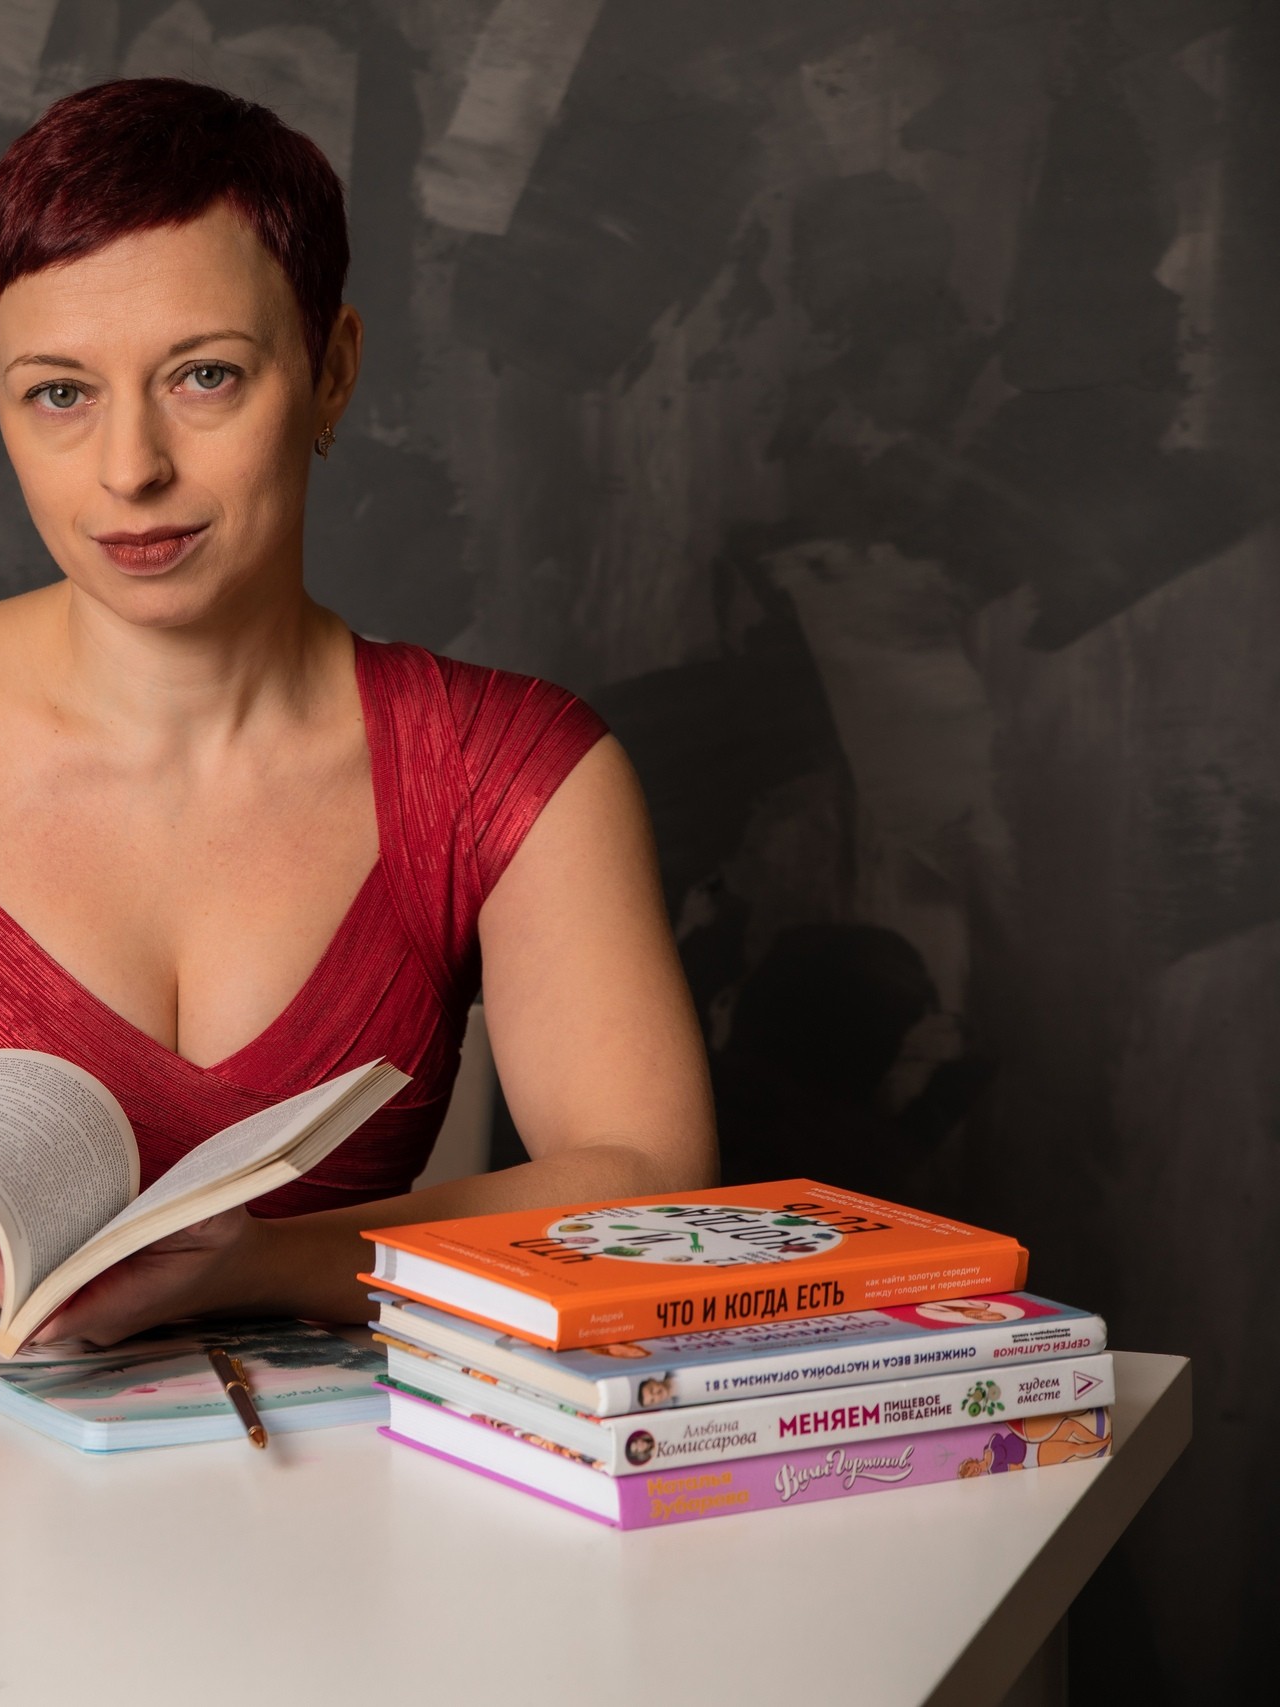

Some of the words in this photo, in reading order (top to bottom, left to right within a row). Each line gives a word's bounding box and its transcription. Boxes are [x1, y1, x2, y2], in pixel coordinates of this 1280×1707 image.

[771, 1202, 894, 1235] ЕСТЬ
[664, 1207, 820, 1250] КОГДА
[618, 1232, 685, 1246] И
[510, 1237, 605, 1264] ЧТО
[865, 1279, 880, 1288] как
[882, 1274, 905, 1285] найти
[908, 1270, 941, 1282] золотую
[942, 1265, 981, 1278] середину
[864, 1288, 892, 1299] между
[894, 1284, 928, 1295] голодом
[938, 1276, 992, 1289] перееданием
[656, 1299, 694, 1328] ЧТО
[702, 1296, 717, 1323] И
[724, 1287, 789, 1319] КОГДА
[797, 1280, 845, 1311] ЕСТЬ
[590, 1311, 624, 1325] Андрей
[579, 1323, 635, 1339] Беловешкин
[741, 1320, 891, 1342] СНИЖЕНИЕ
[662, 1340, 735, 1351] ВЕСА
[993, 1343, 1051, 1359] САЛТЫКОВ
[1053, 1338, 1091, 1352] СЕРГЕЙ
[872, 1360, 880, 1370] И
[883, 1356, 911, 1368] ВЕСА
[913, 1347, 977, 1365] СНИЖЕНИЕ
[731, 1372, 799, 1388] ОРГАНИЗМА
[801, 1362, 870, 1381] НАСТРОЙКА
[705, 1381, 711, 1392] 1
[722, 1379, 729, 1389] 3
[1018, 1377, 1061, 1394] худеем
[883, 1394, 941, 1412] ПИЩЕВОЕ
[1017, 1391, 1061, 1405] вместе
[778, 1404, 881, 1438] МЕНЯЕМ
[883, 1404, 952, 1424] ПОВЕДЕНИЕ
[683, 1420, 739, 1438] Альбина
[656, 1430, 757, 1458] Комиссарова
[775, 1462, 833, 1502] Вальс
[826, 1444, 916, 1491] Гормонов
[647, 1469, 733, 1497] Наталья
[649, 1489, 750, 1520] Зубарева
